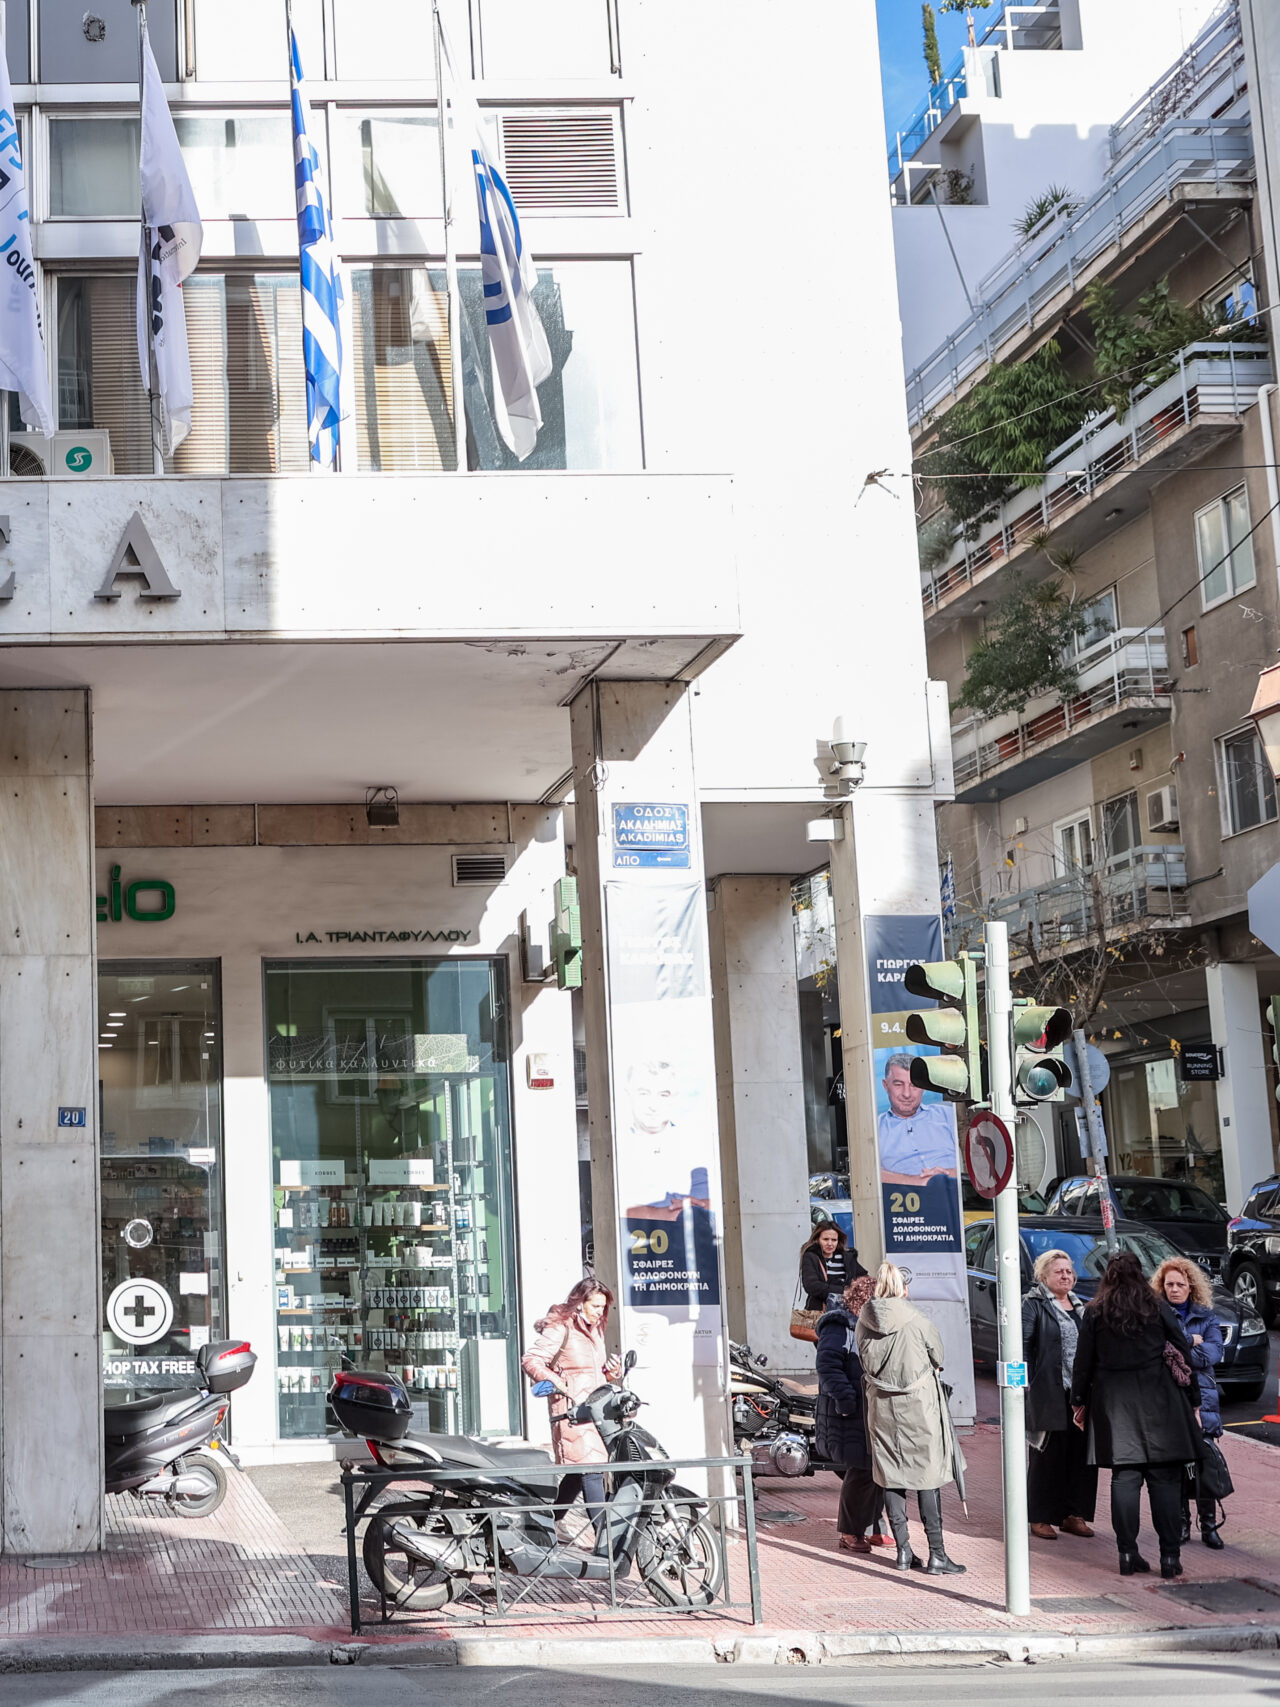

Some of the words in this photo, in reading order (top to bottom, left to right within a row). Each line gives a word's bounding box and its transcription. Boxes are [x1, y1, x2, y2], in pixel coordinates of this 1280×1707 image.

[634, 807, 672, 817] ΟΔΟΣ
[619, 819, 684, 831] ΑΚΑΔΗΜΙΑΣ
[619, 833, 684, 842] AKADIMIAS
[616, 856, 640, 865] ΑΠΟ
[325, 930, 472, 943] ΤΡΙΑΝΤΑΦΥΛΛΟΥ
[276, 1057, 335, 1071] φυτικά
[340, 1056, 437, 1069] καλλυντικά
[64, 1111, 79, 1124] 20
[889, 1192, 921, 1213] 20
[630, 1229, 669, 1254] 20
[906, 1234, 955, 1242] ΔΗΜΟΚΡΑΤΙΑ
[632, 1260, 674, 1269] ΣΦΑΙΡΕΣ
[633, 1271, 700, 1281] ΔΟΛΟΦΟΝΟΥΝ
[633, 1283, 647, 1292] ΤΗ
[649, 1282, 710, 1291] ΔΗΜΟΚΡΑΤΙΑ
[133, 1361, 159, 1374] TAX
[161, 1360, 196, 1374] FREE
